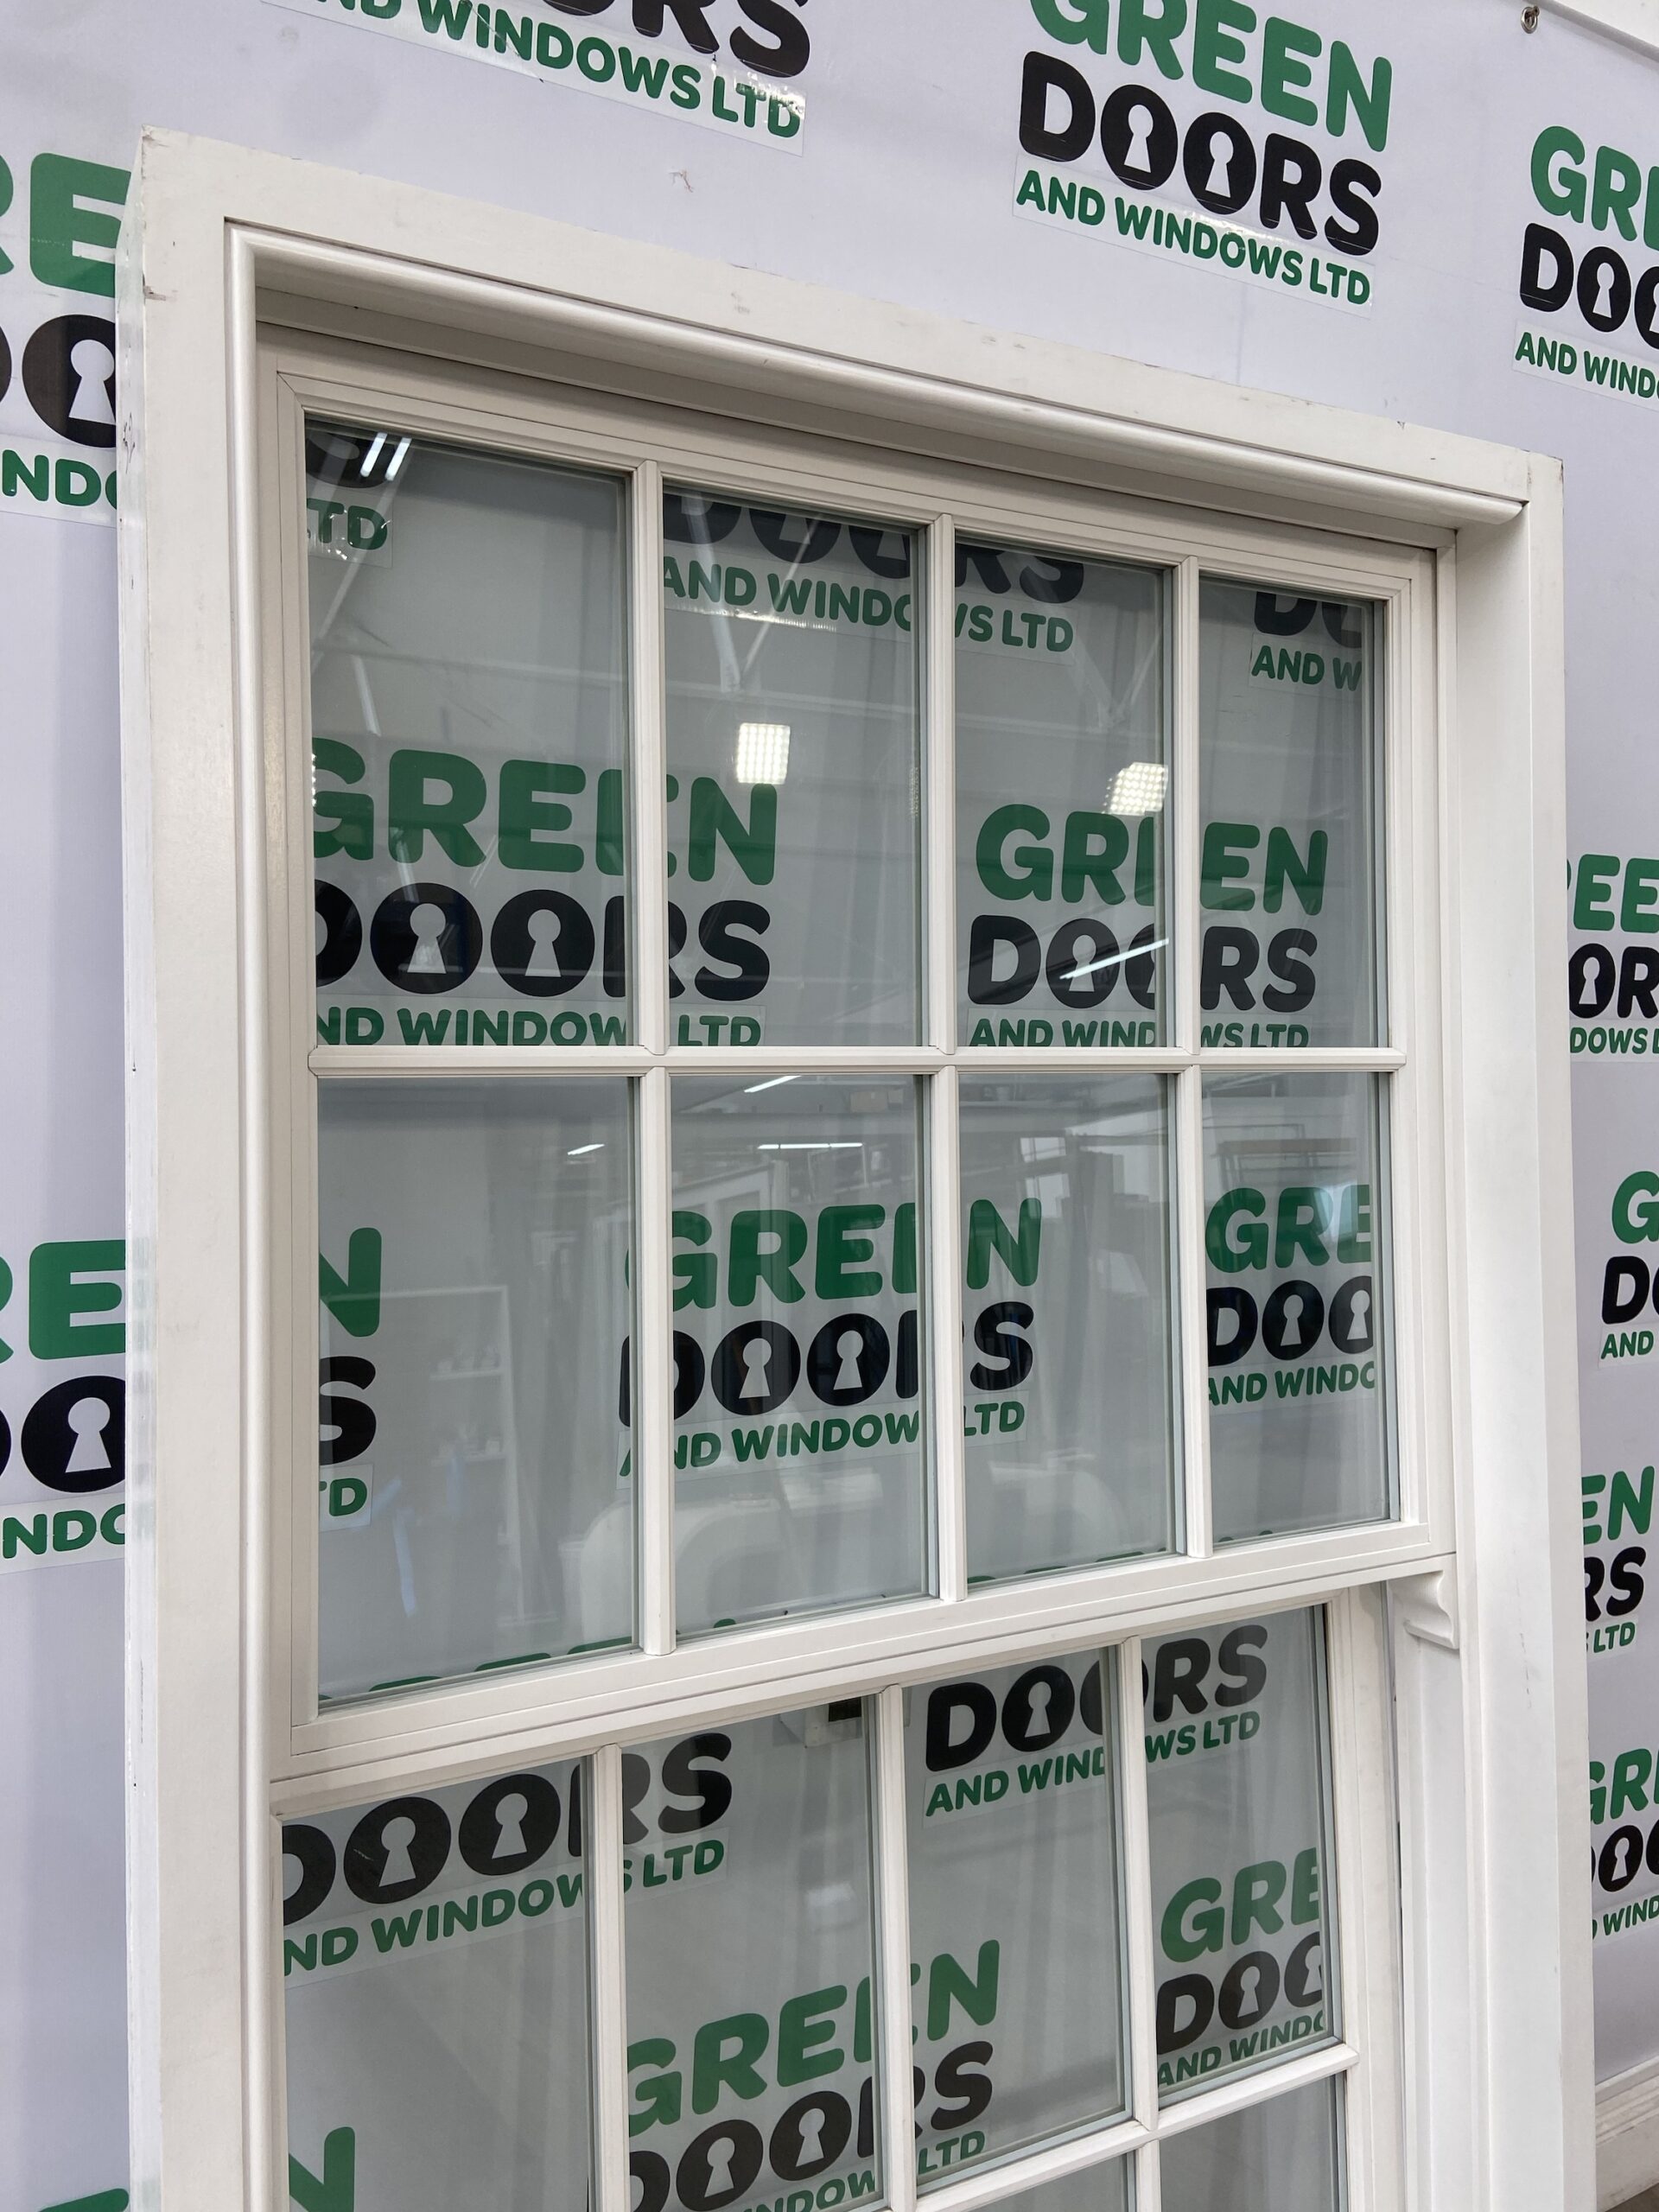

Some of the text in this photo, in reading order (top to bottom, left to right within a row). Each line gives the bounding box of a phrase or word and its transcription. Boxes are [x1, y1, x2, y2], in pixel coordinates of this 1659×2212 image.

[417, 0, 702, 111] WINDOWS
[711, 75, 801, 139] LTD
[1019, 51, 1382, 256] DOORS
[1016, 170, 1370, 305] AND WINDOWS LTD
[1515, 332, 1659, 399] AND WIND
[307, 498, 388, 550] TD
[1002, 610, 1074, 652] LTD
[1251, 645, 1325, 685] AND
[316, 1007, 385, 1046] ND
[397, 1008, 626, 1046] WINDOW
[969, 1019, 1053, 1047] AND
[1570, 1027, 1649, 1054] DOWS
[1205, 1185, 1371, 1273] GRE
[1206, 1275, 1374, 1367] DOO
[1601, 1330, 1655, 1360] AND
[1274, 1361, 1376, 1398] WINDO
[732, 1409, 919, 1462] WINDOW
[1593, 1622, 1636, 1653] LTD
[925, 1770, 1009, 1817] AND
[1203, 1711, 1261, 1750] LTD
[283, 1927, 359, 1976] ND
[643, 1840, 725, 1888] LTD
[1160, 1847, 1320, 1962] GRE
[1603, 1894, 1659, 1936] WIND
[1156, 1931, 1323, 2055] DOO
[918, 2131, 985, 2175] LTD
